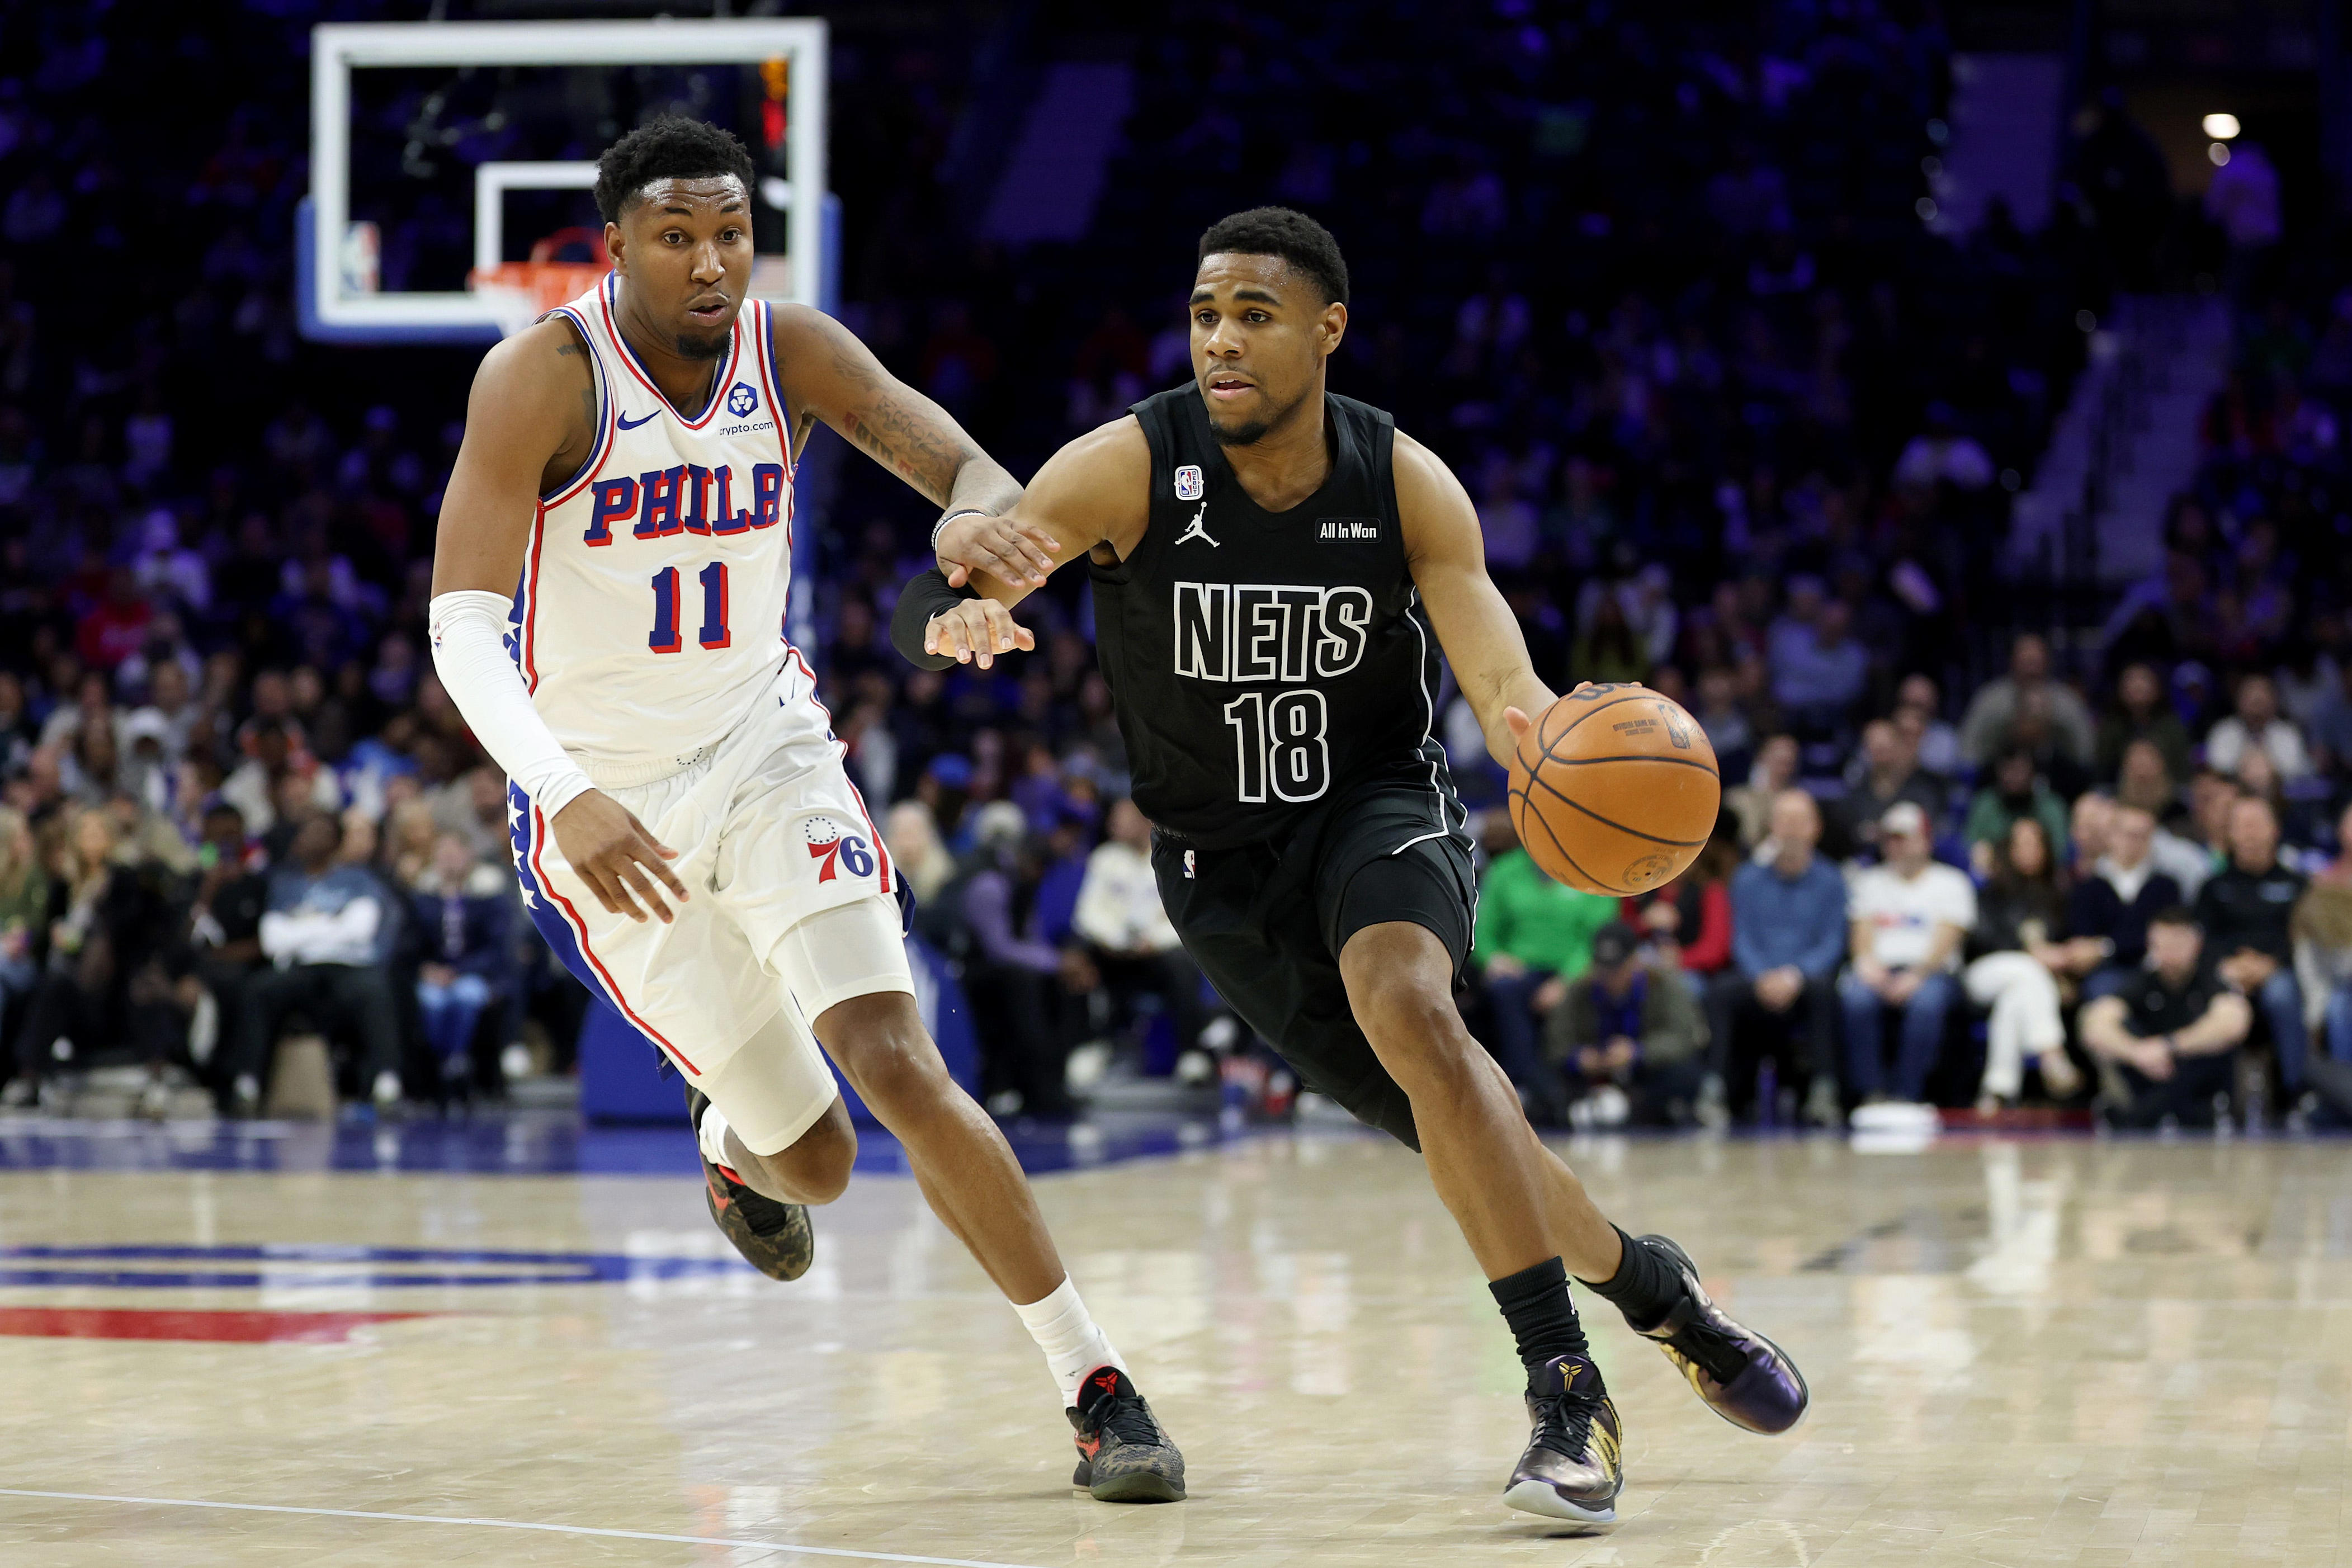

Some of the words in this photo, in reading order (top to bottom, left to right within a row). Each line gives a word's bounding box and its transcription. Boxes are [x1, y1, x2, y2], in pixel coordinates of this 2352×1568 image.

[584, 463, 785, 547] PHILA
[1320, 522, 1336, 539] All
[1338, 522, 1349, 539] In
[1350, 522, 1377, 539] Won
[649, 561, 731, 654] 11
[1174, 581, 1373, 682] NETS
[1224, 689, 1330, 803] 18
[806, 835, 874, 885] 76
